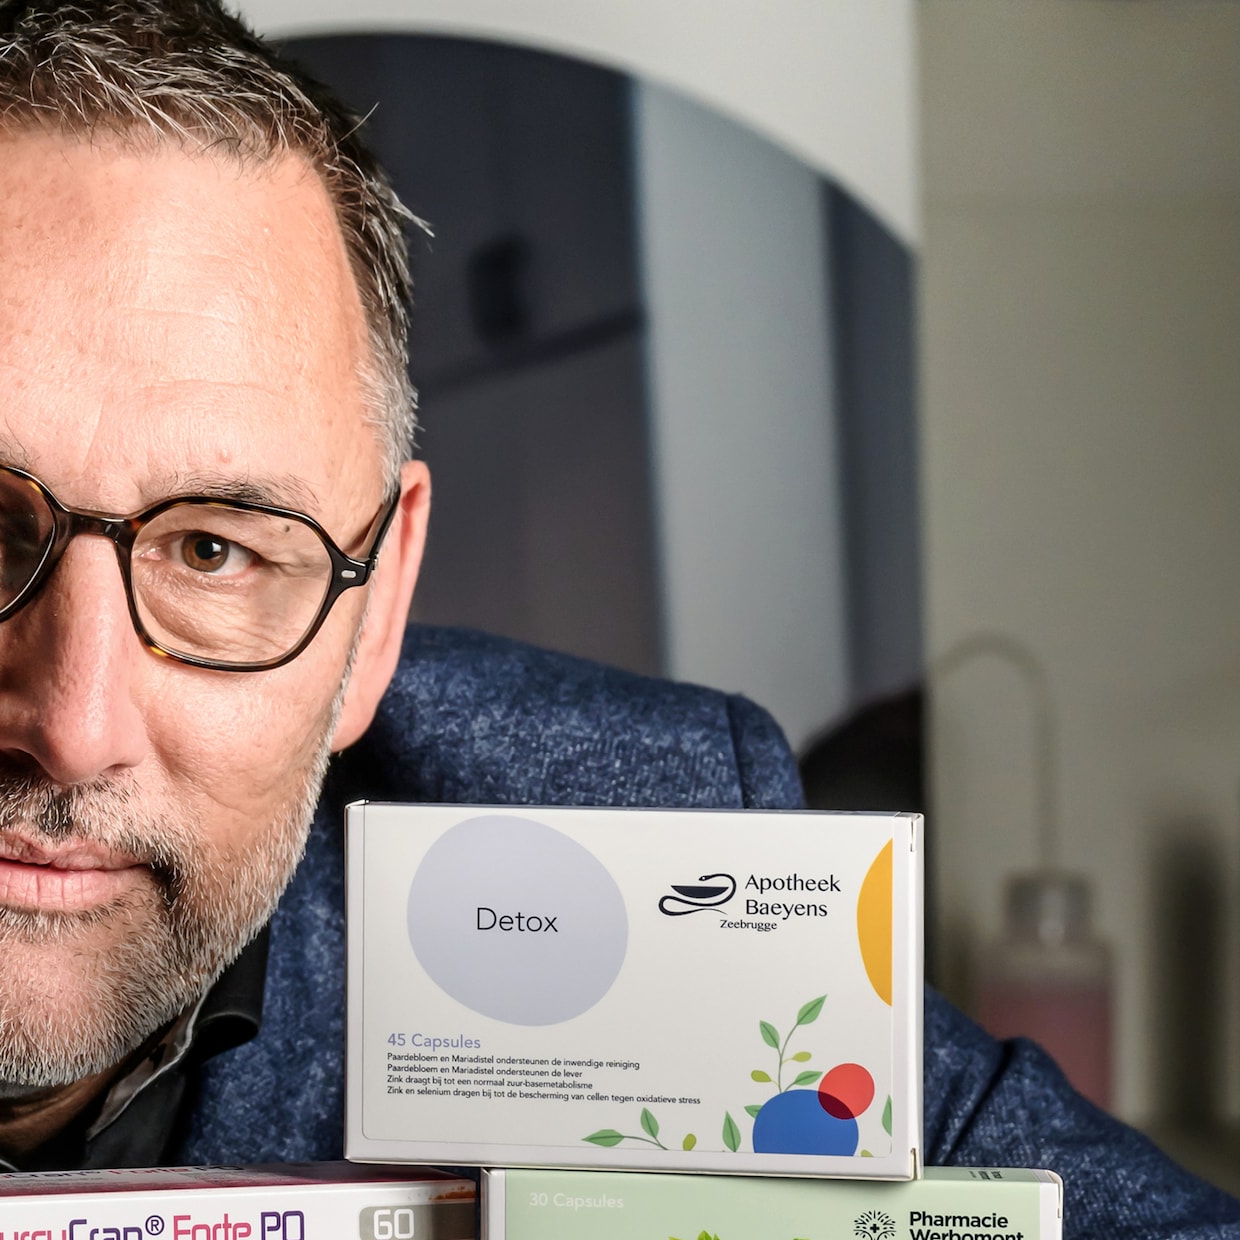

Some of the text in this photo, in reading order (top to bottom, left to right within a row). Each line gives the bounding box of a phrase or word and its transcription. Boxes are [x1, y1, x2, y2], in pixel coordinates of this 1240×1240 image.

[745, 873, 841, 894] Apotheek
[746, 899, 828, 920] Baeyens
[476, 907, 558, 933] Detox
[720, 919, 778, 932] Zeebrugge
[387, 1033, 481, 1052] 45 Capsules
[387, 1053, 438, 1063] Paardebloem
[451, 1055, 494, 1064] Mariadistel
[496, 1056, 549, 1066] ondersteunen
[551, 1058, 562, 1066] de
[563, 1058, 604, 1069] inwendige
[606, 1060, 640, 1070] reiniging
[387, 1064, 438, 1074] Paardebloem
[451, 1066, 494, 1075] Mariadistel
[496, 1067, 549, 1077] ondersteunen
[551, 1069, 562, 1077] de
[563, 1070, 583, 1078] lever
[387, 1075, 403, 1083] Zink
[405, 1075, 431, 1086] draagt
[432, 1076, 442, 1086] bij
[444, 1077, 455, 1085] tot
[473, 1078, 505, 1087] normaal
[506, 1079, 593, 1090] zuur-basemetabolisme
[387, 1086, 403, 1095] Zink
[417, 1087, 451, 1096] selenium
[452, 1088, 480, 1099] dragen
[482, 1089, 492, 1099] bij
[493, 1090, 505, 1098] tot
[507, 1090, 518, 1098] de
[519, 1090, 569, 1102] bescherming
[586, 1092, 609, 1101] cellen
[611, 1094, 635, 1103] tegen
[636, 1094, 677, 1104] oxidatieve
[678, 1096, 701, 1105] stress
[528, 1193, 624, 1212] 30 Capsules
[373, 1208, 415, 1240] 60
[909, 1211, 1008, 1229] Pharmacie
